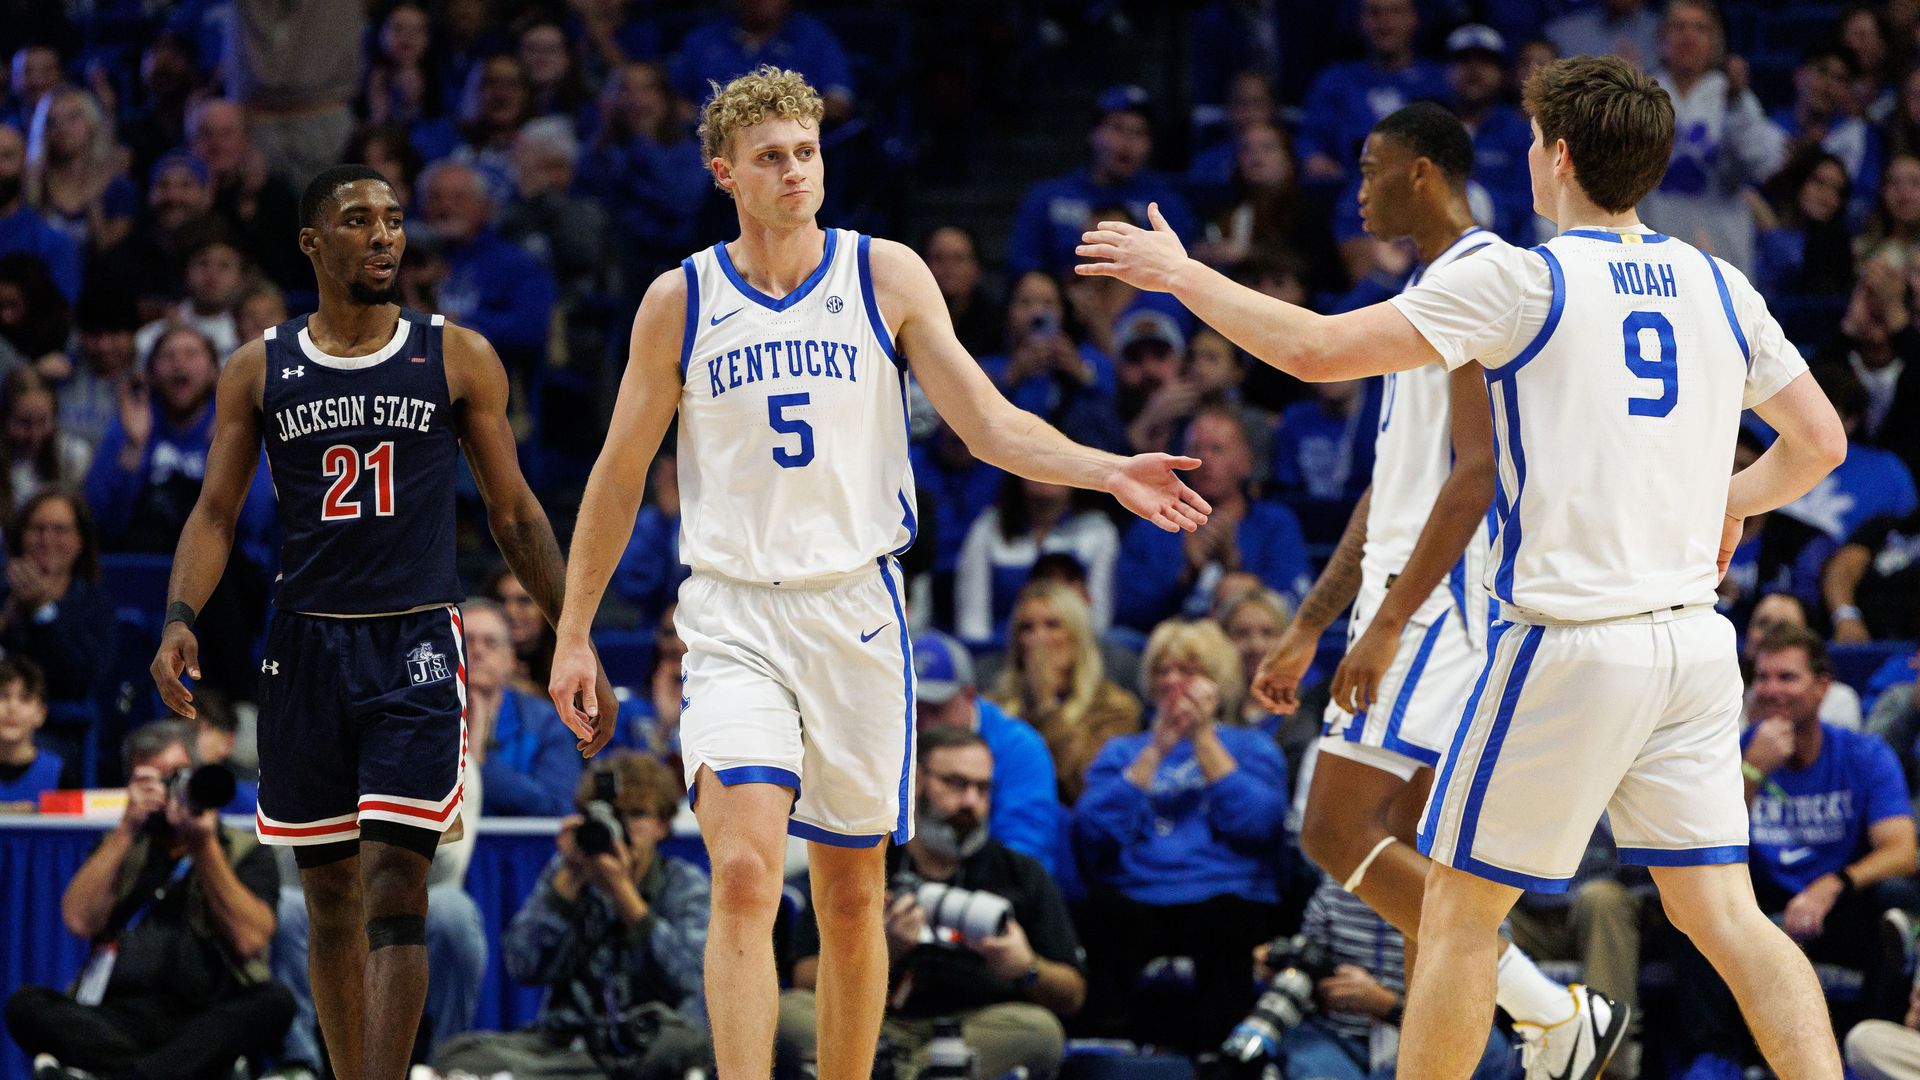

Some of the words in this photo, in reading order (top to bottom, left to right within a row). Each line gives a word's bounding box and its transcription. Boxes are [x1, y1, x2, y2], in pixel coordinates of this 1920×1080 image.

[828, 297, 843, 312] SEC
[1608, 262, 1677, 297] NOAH
[708, 340, 857, 398] KENTUCKY
[1623, 311, 1678, 418] 9
[276, 396, 365, 442] JACKSON
[373, 396, 436, 433] STATE
[767, 392, 815, 468] 5
[321, 441, 395, 521] 21
[1751, 790, 1852, 824] ENTUCKY
